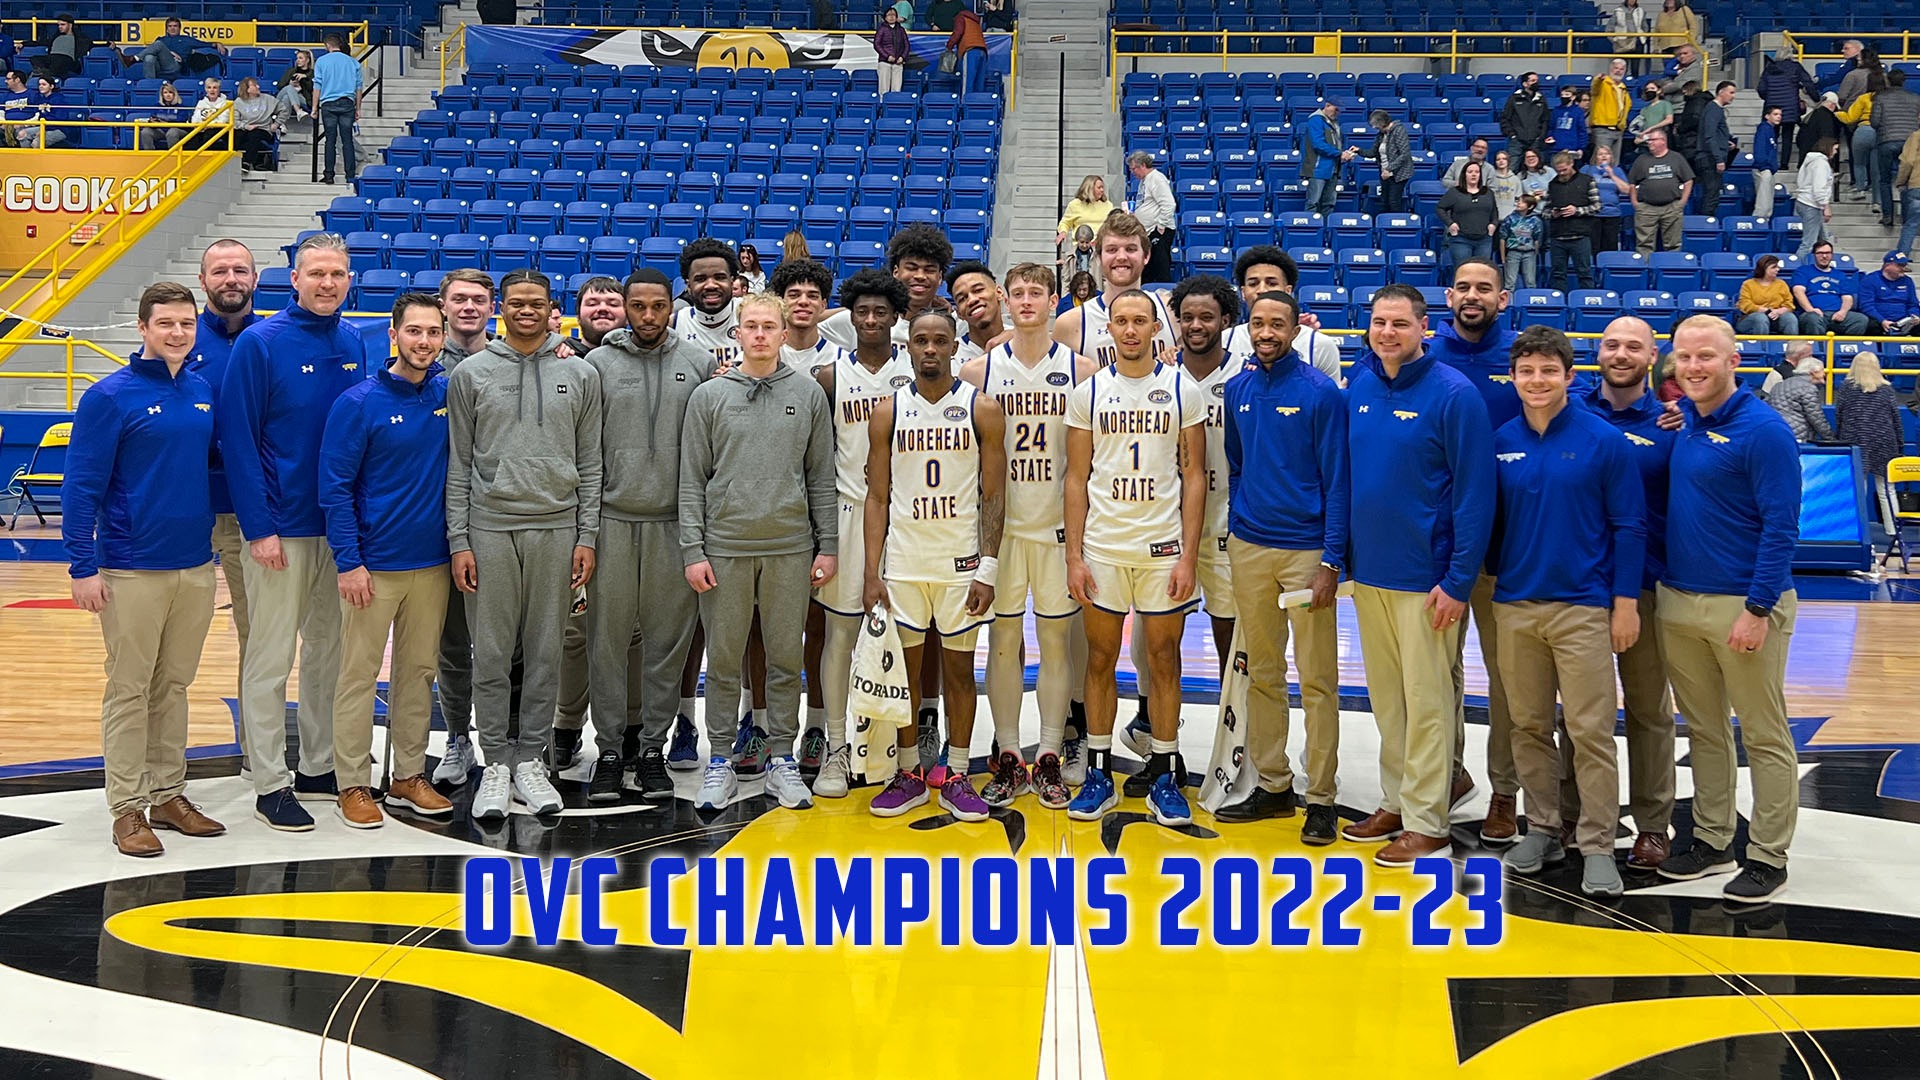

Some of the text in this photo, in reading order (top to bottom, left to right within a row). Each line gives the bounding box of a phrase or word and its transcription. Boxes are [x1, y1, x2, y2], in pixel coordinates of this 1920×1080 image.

[127, 23, 141, 41] B
[183, 26, 233, 39] SERVED
[4, 175, 190, 214] COOK OU
[996, 392, 1067, 416] MOREHEAD
[1099, 410, 1170, 435] MOREHEAD
[897, 428, 970, 452] MOREHEAD
[1015, 422, 1047, 452] 24
[1129, 441, 1140, 471] 1
[925, 458, 941, 488] 0
[1010, 458, 1052, 482] STATE
[1112, 477, 1155, 501] STATE
[913, 495, 957, 520] STATE
